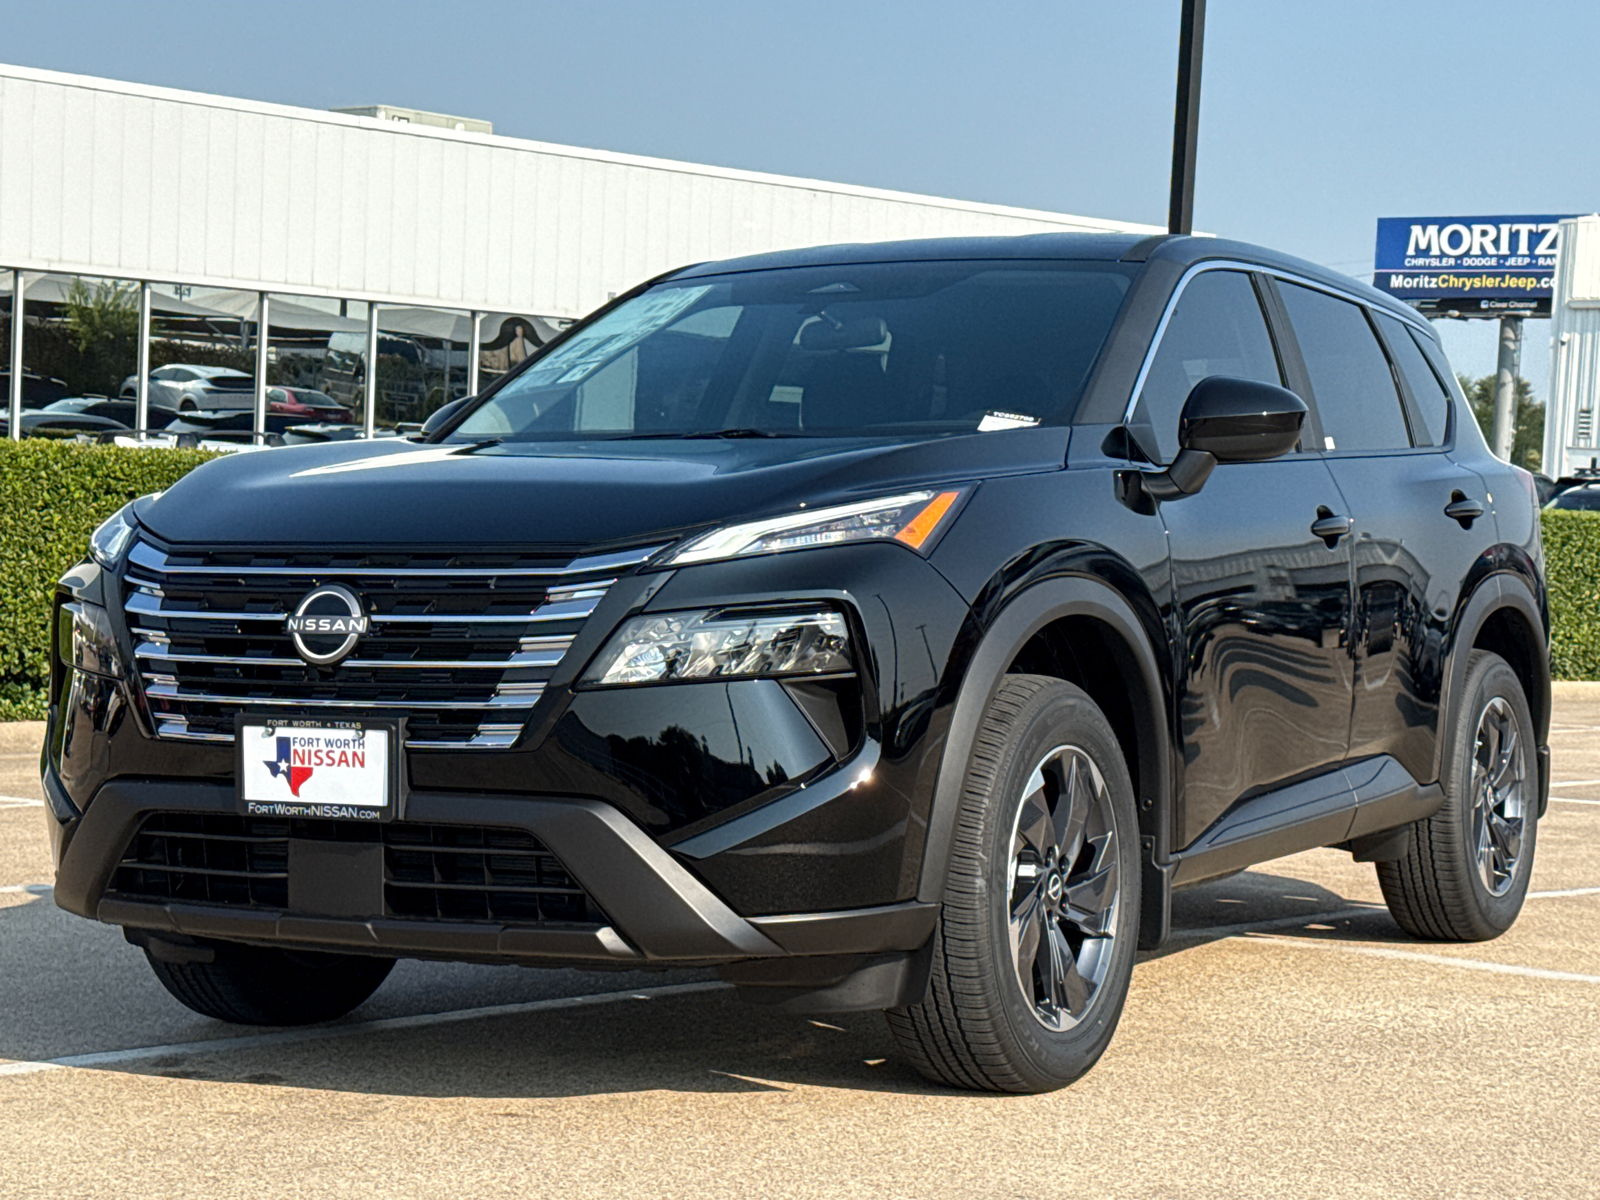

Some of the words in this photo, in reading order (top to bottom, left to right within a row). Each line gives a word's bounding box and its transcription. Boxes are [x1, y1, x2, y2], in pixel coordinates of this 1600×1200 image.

[1406, 223, 1558, 256] MORITZ
[1404, 257, 1455, 267] CHRYSLER
[1463, 256, 1498, 267] DODGE
[1505, 256, 1531, 267] JEEP
[1390, 273, 1557, 291] MoritzChryslerJeep.co
[287, 618, 364, 632] NISSAN
[266, 719, 289, 727] FORT
[292, 720, 322, 728] WORTH
[334, 721, 362, 729] TEXAS
[292, 737, 321, 748] FORT
[323, 738, 365, 750] WORTH
[292, 748, 365, 768] NISSAN
